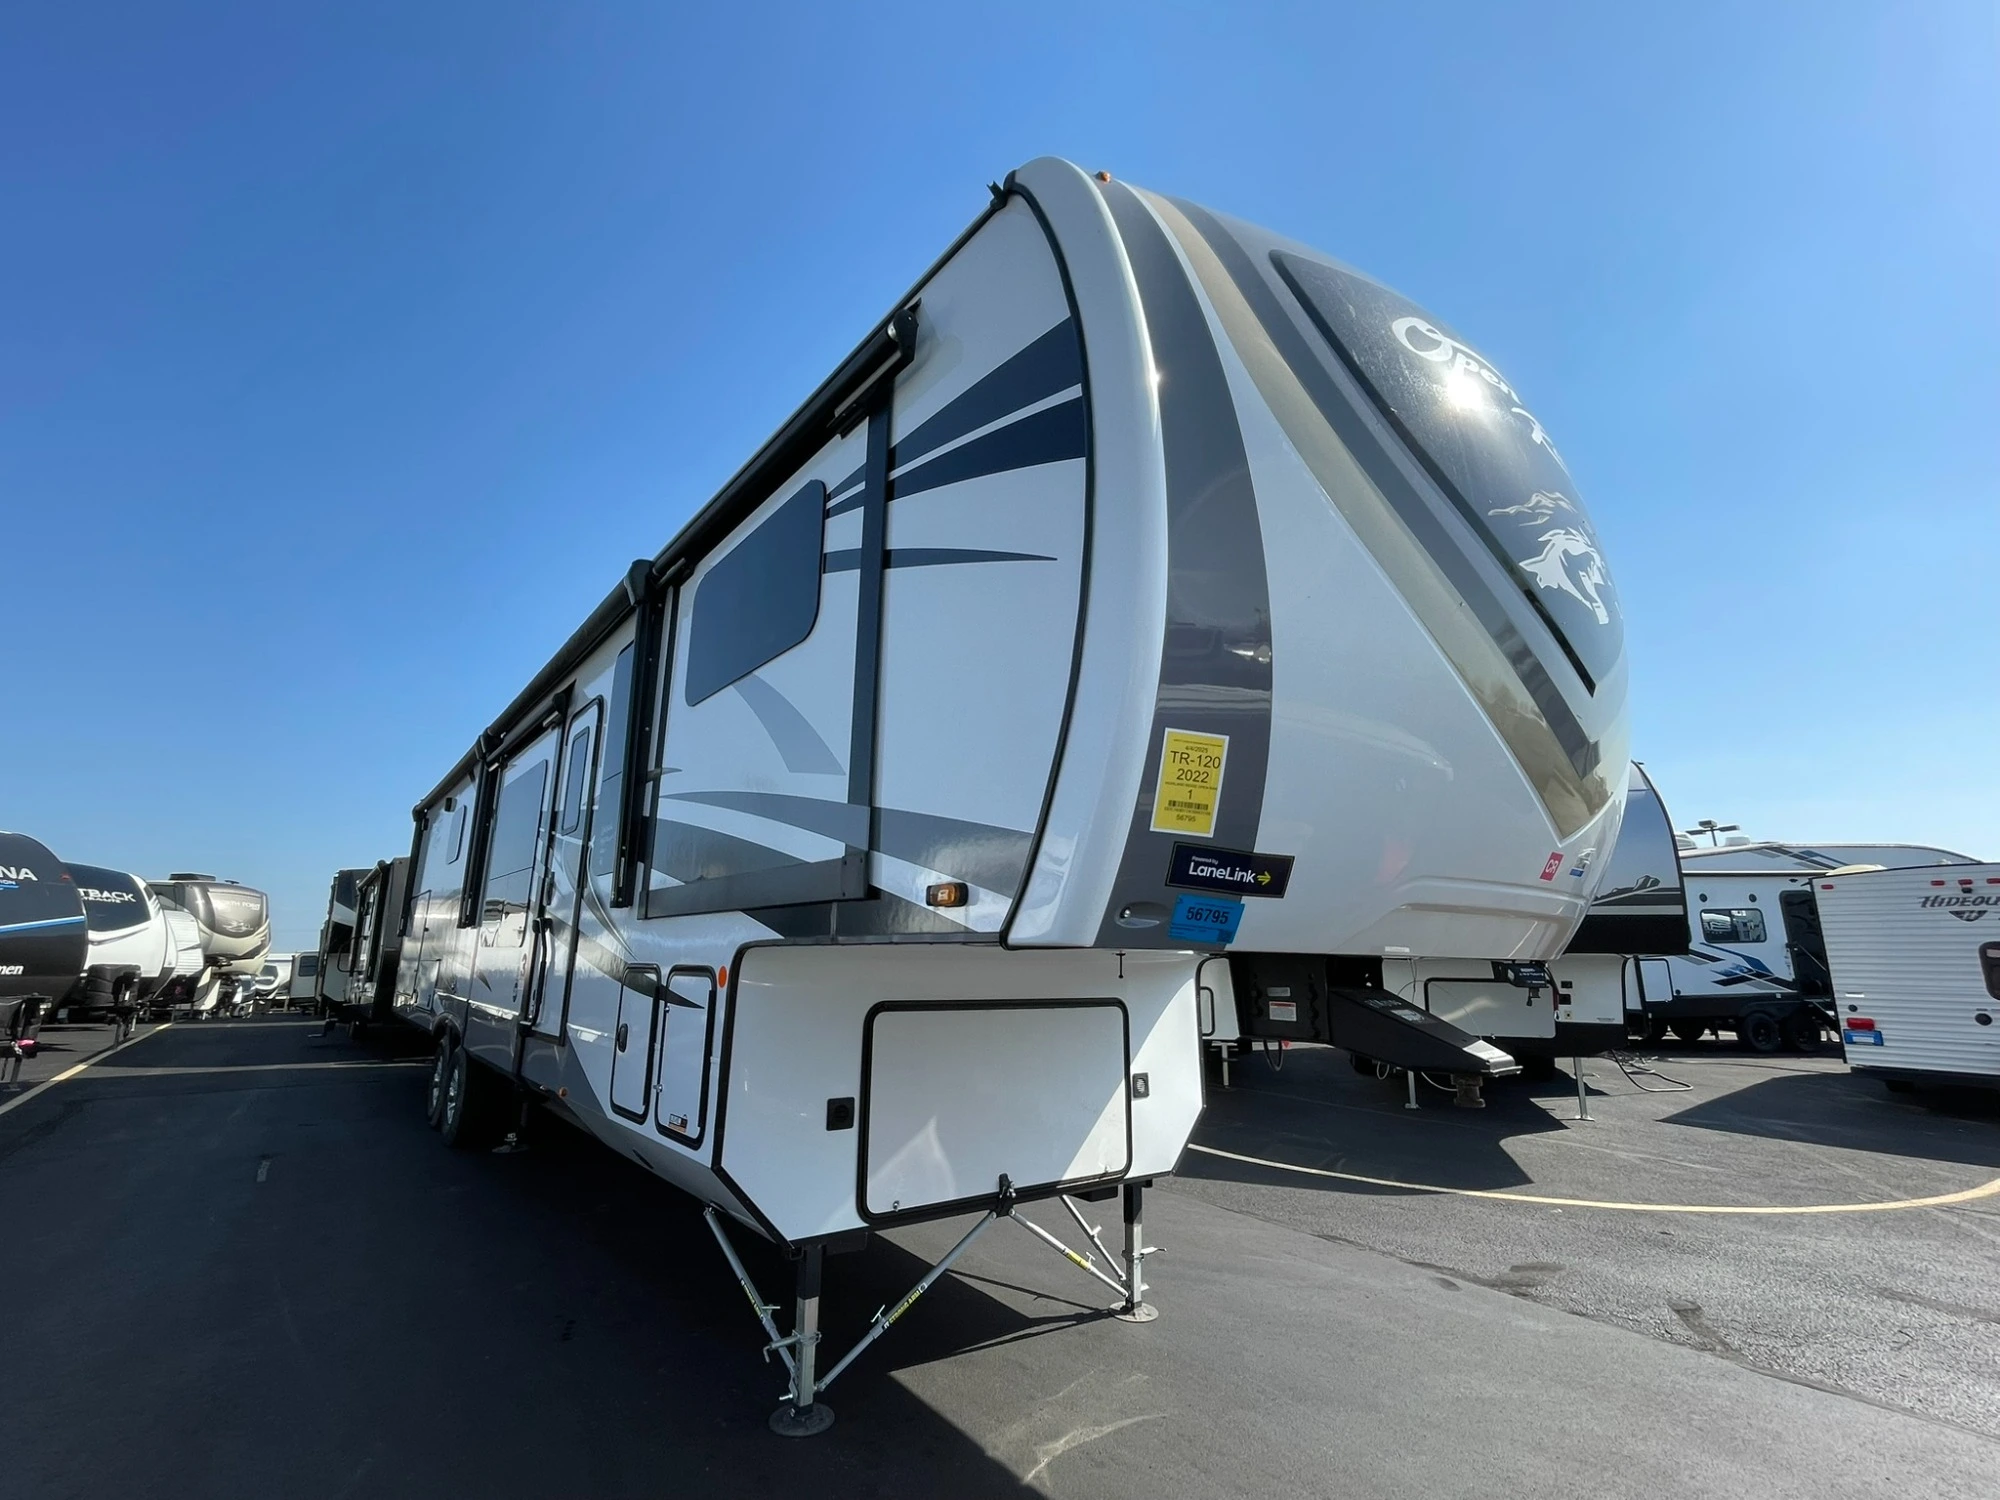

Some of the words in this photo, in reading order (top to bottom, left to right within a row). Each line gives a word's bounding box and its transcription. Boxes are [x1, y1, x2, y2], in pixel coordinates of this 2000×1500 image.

[1170, 750, 1221, 769] TR-120
[1176, 768, 1210, 783] 2022
[1187, 788, 1193, 800] 1
[1188, 861, 1256, 883] LaneLink
[1545, 859, 1560, 874] CR
[77, 887, 137, 903] TBACK
[1186, 906, 1230, 925] 56795
